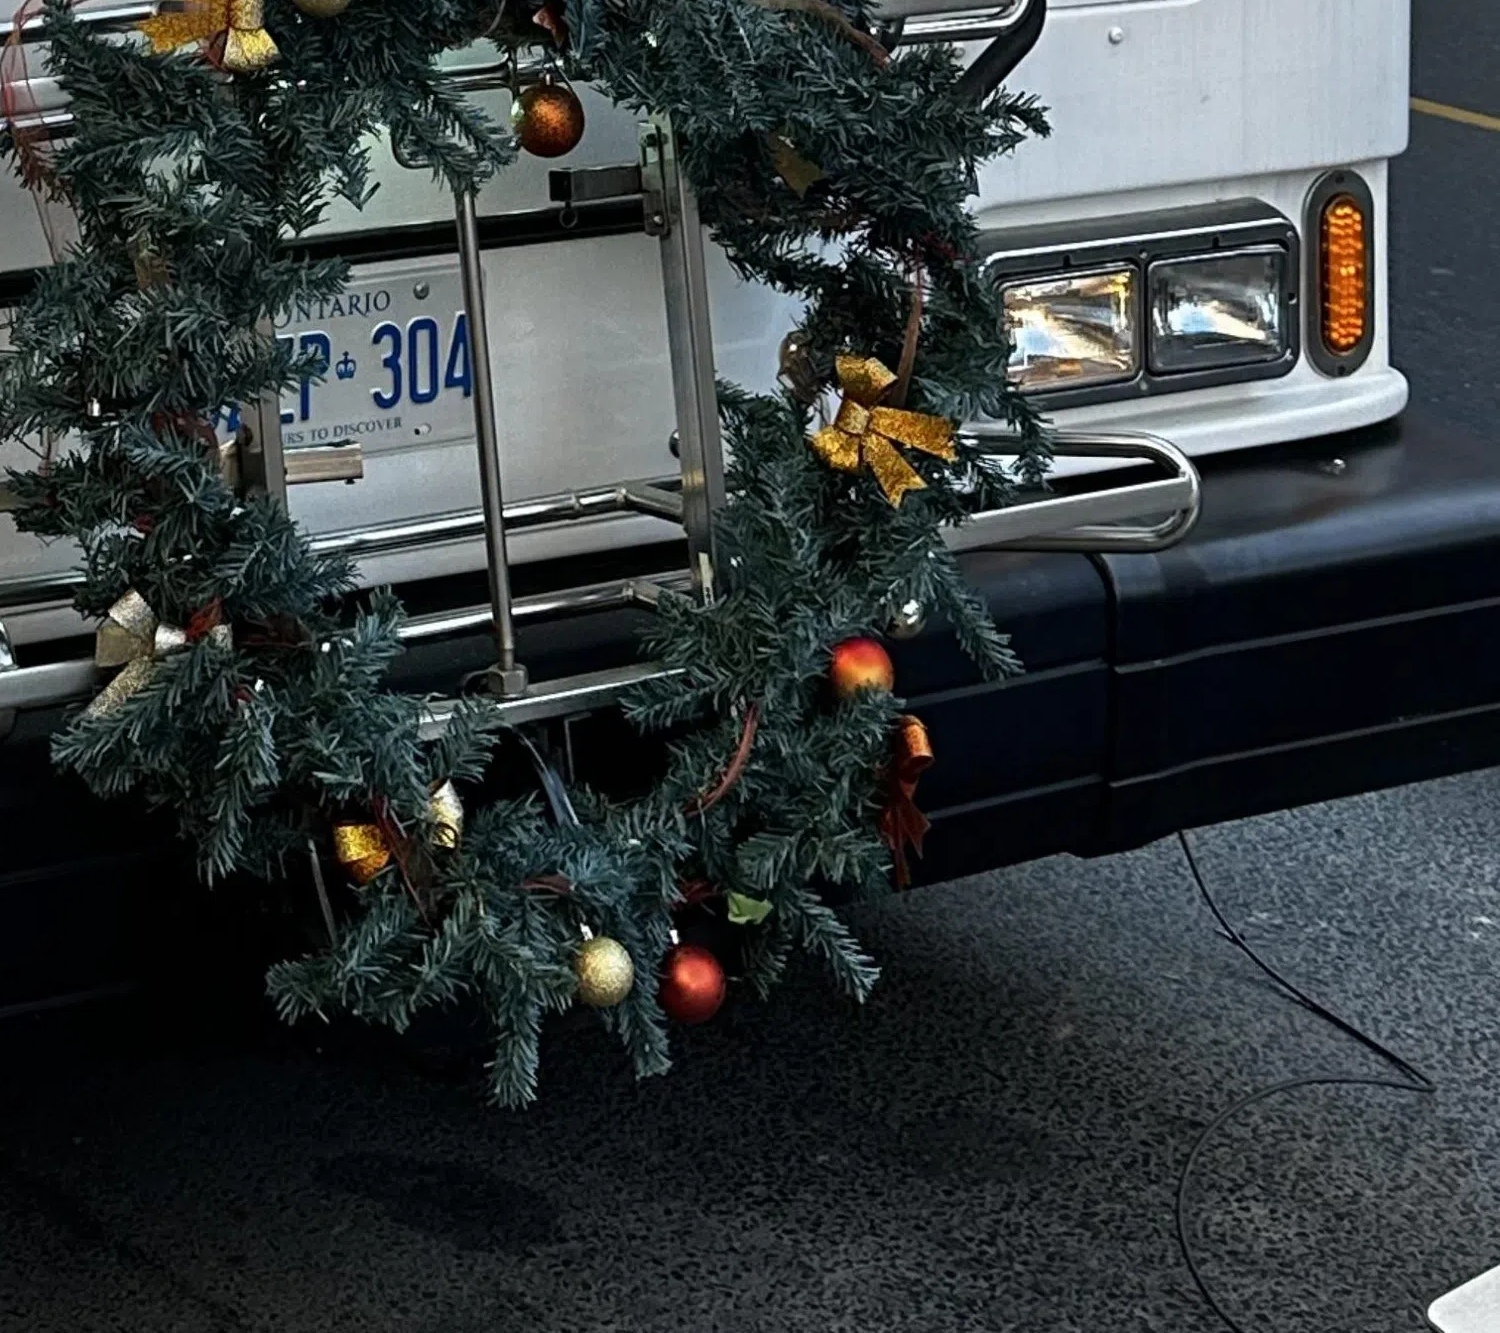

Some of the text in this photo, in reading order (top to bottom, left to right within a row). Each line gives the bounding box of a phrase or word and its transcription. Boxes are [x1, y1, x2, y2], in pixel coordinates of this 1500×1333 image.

[370, 310, 473, 410] 304
[311, 426, 329, 441] TO
[334, 416, 403, 438] DISCOVER
